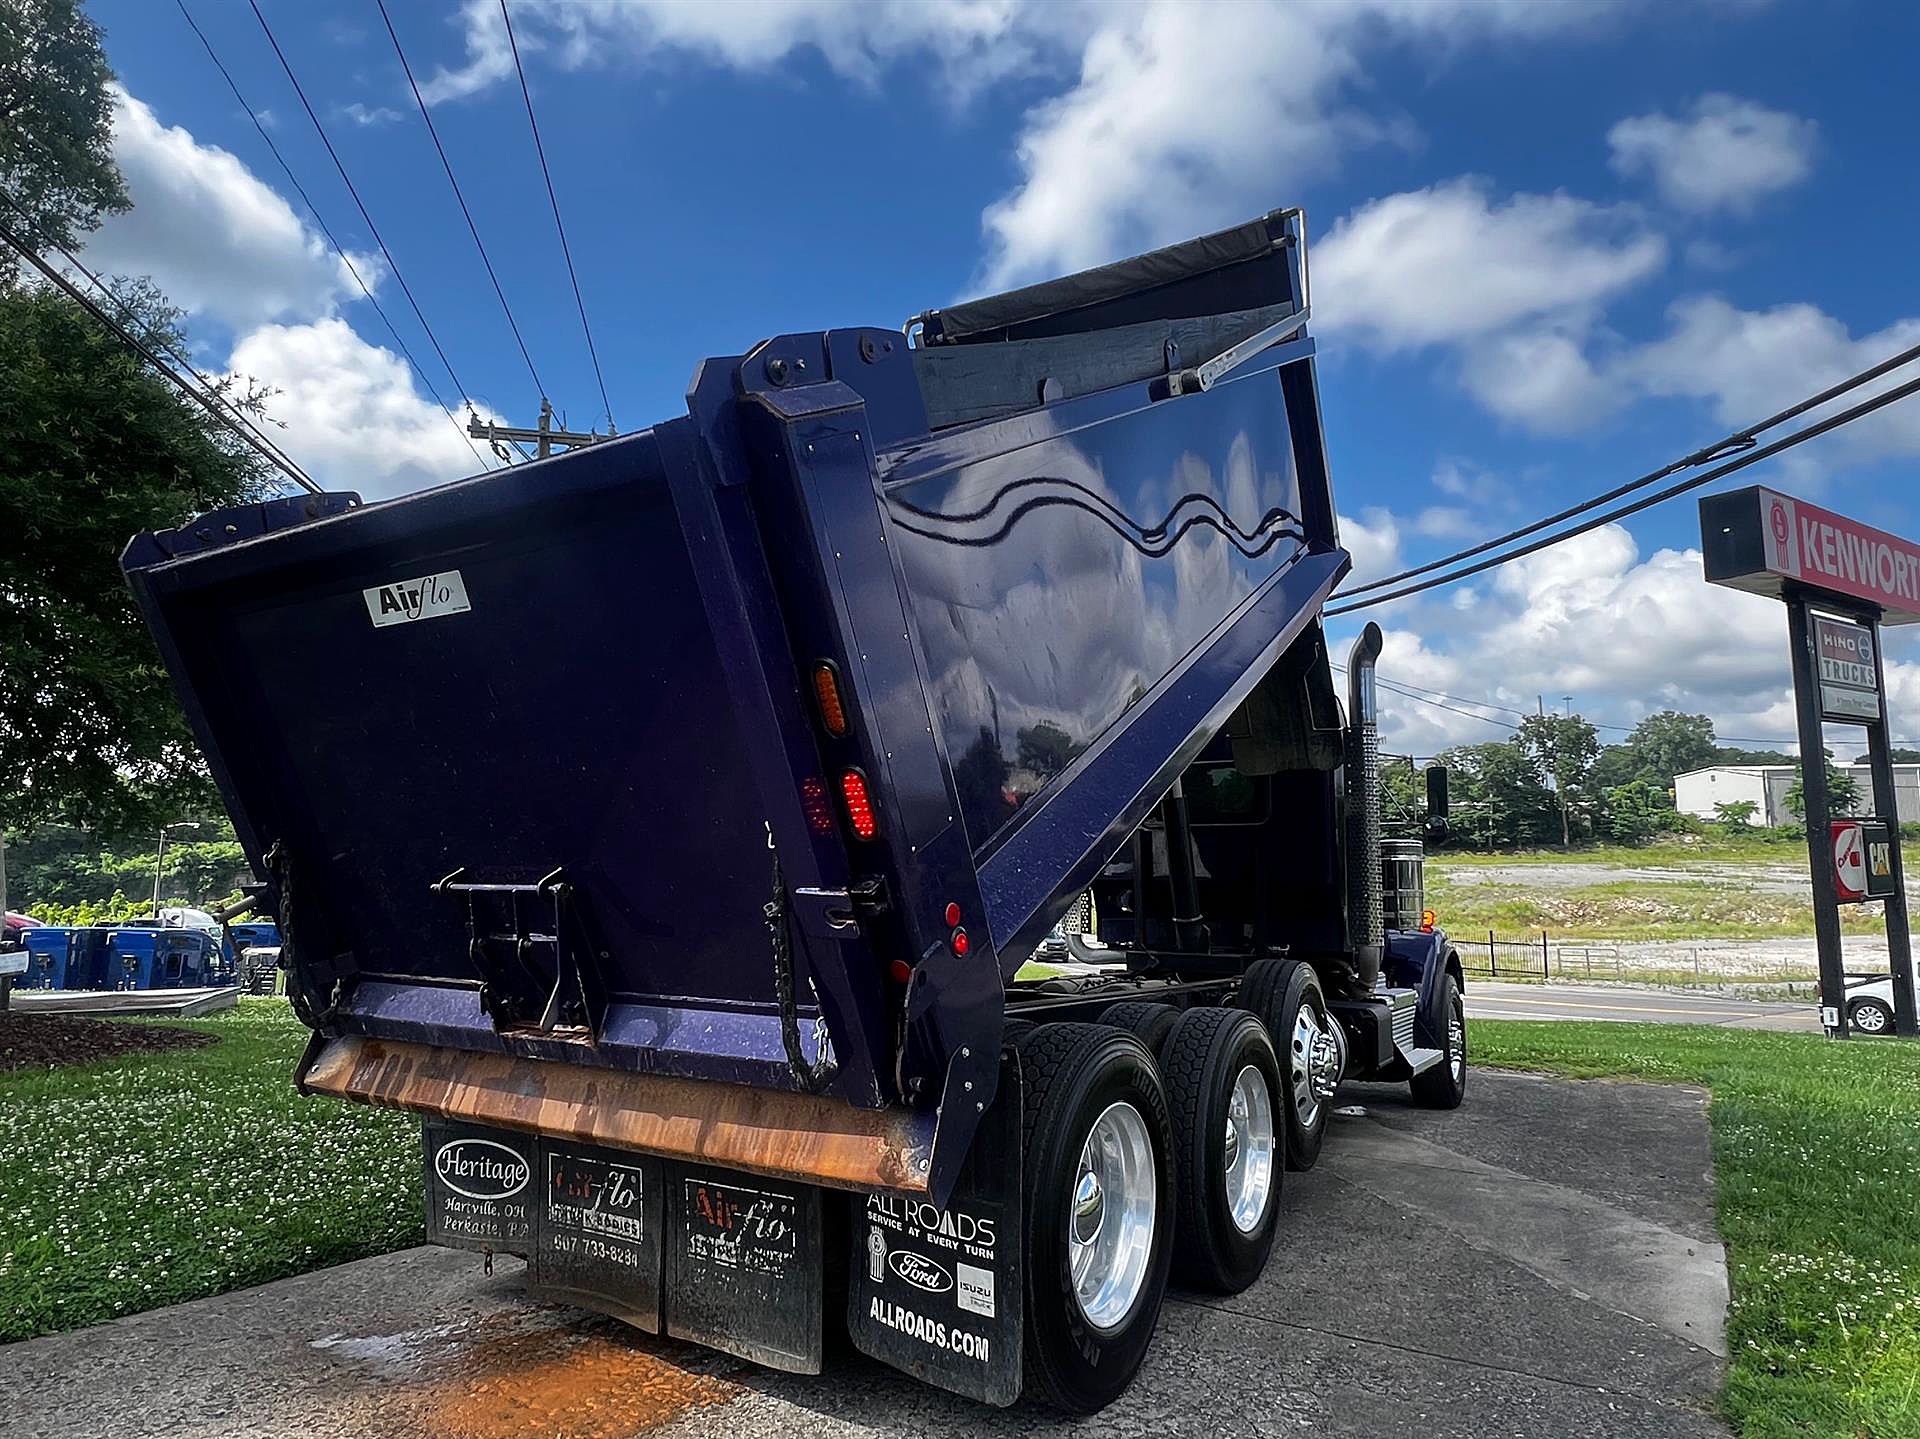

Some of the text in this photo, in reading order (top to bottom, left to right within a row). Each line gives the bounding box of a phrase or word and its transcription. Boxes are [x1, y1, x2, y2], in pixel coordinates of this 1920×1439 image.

[1801, 516, 1920, 601] KENWORT
[379, 576, 450, 619] Airflo
[1823, 633, 1856, 652] HINO
[1823, 660, 1875, 686] TRUCKS
[1869, 842, 1890, 876] CAT
[440, 1147, 525, 1188] Heritage
[444, 1196, 501, 1217] Hartville,
[867, 1210, 994, 1260] SERVICE AT EVERY TURN
[899, 1254, 941, 1288] Ford
[959, 1281, 992, 1297] ISUZU
[870, 1296, 989, 1363] ALLROADS.COM
